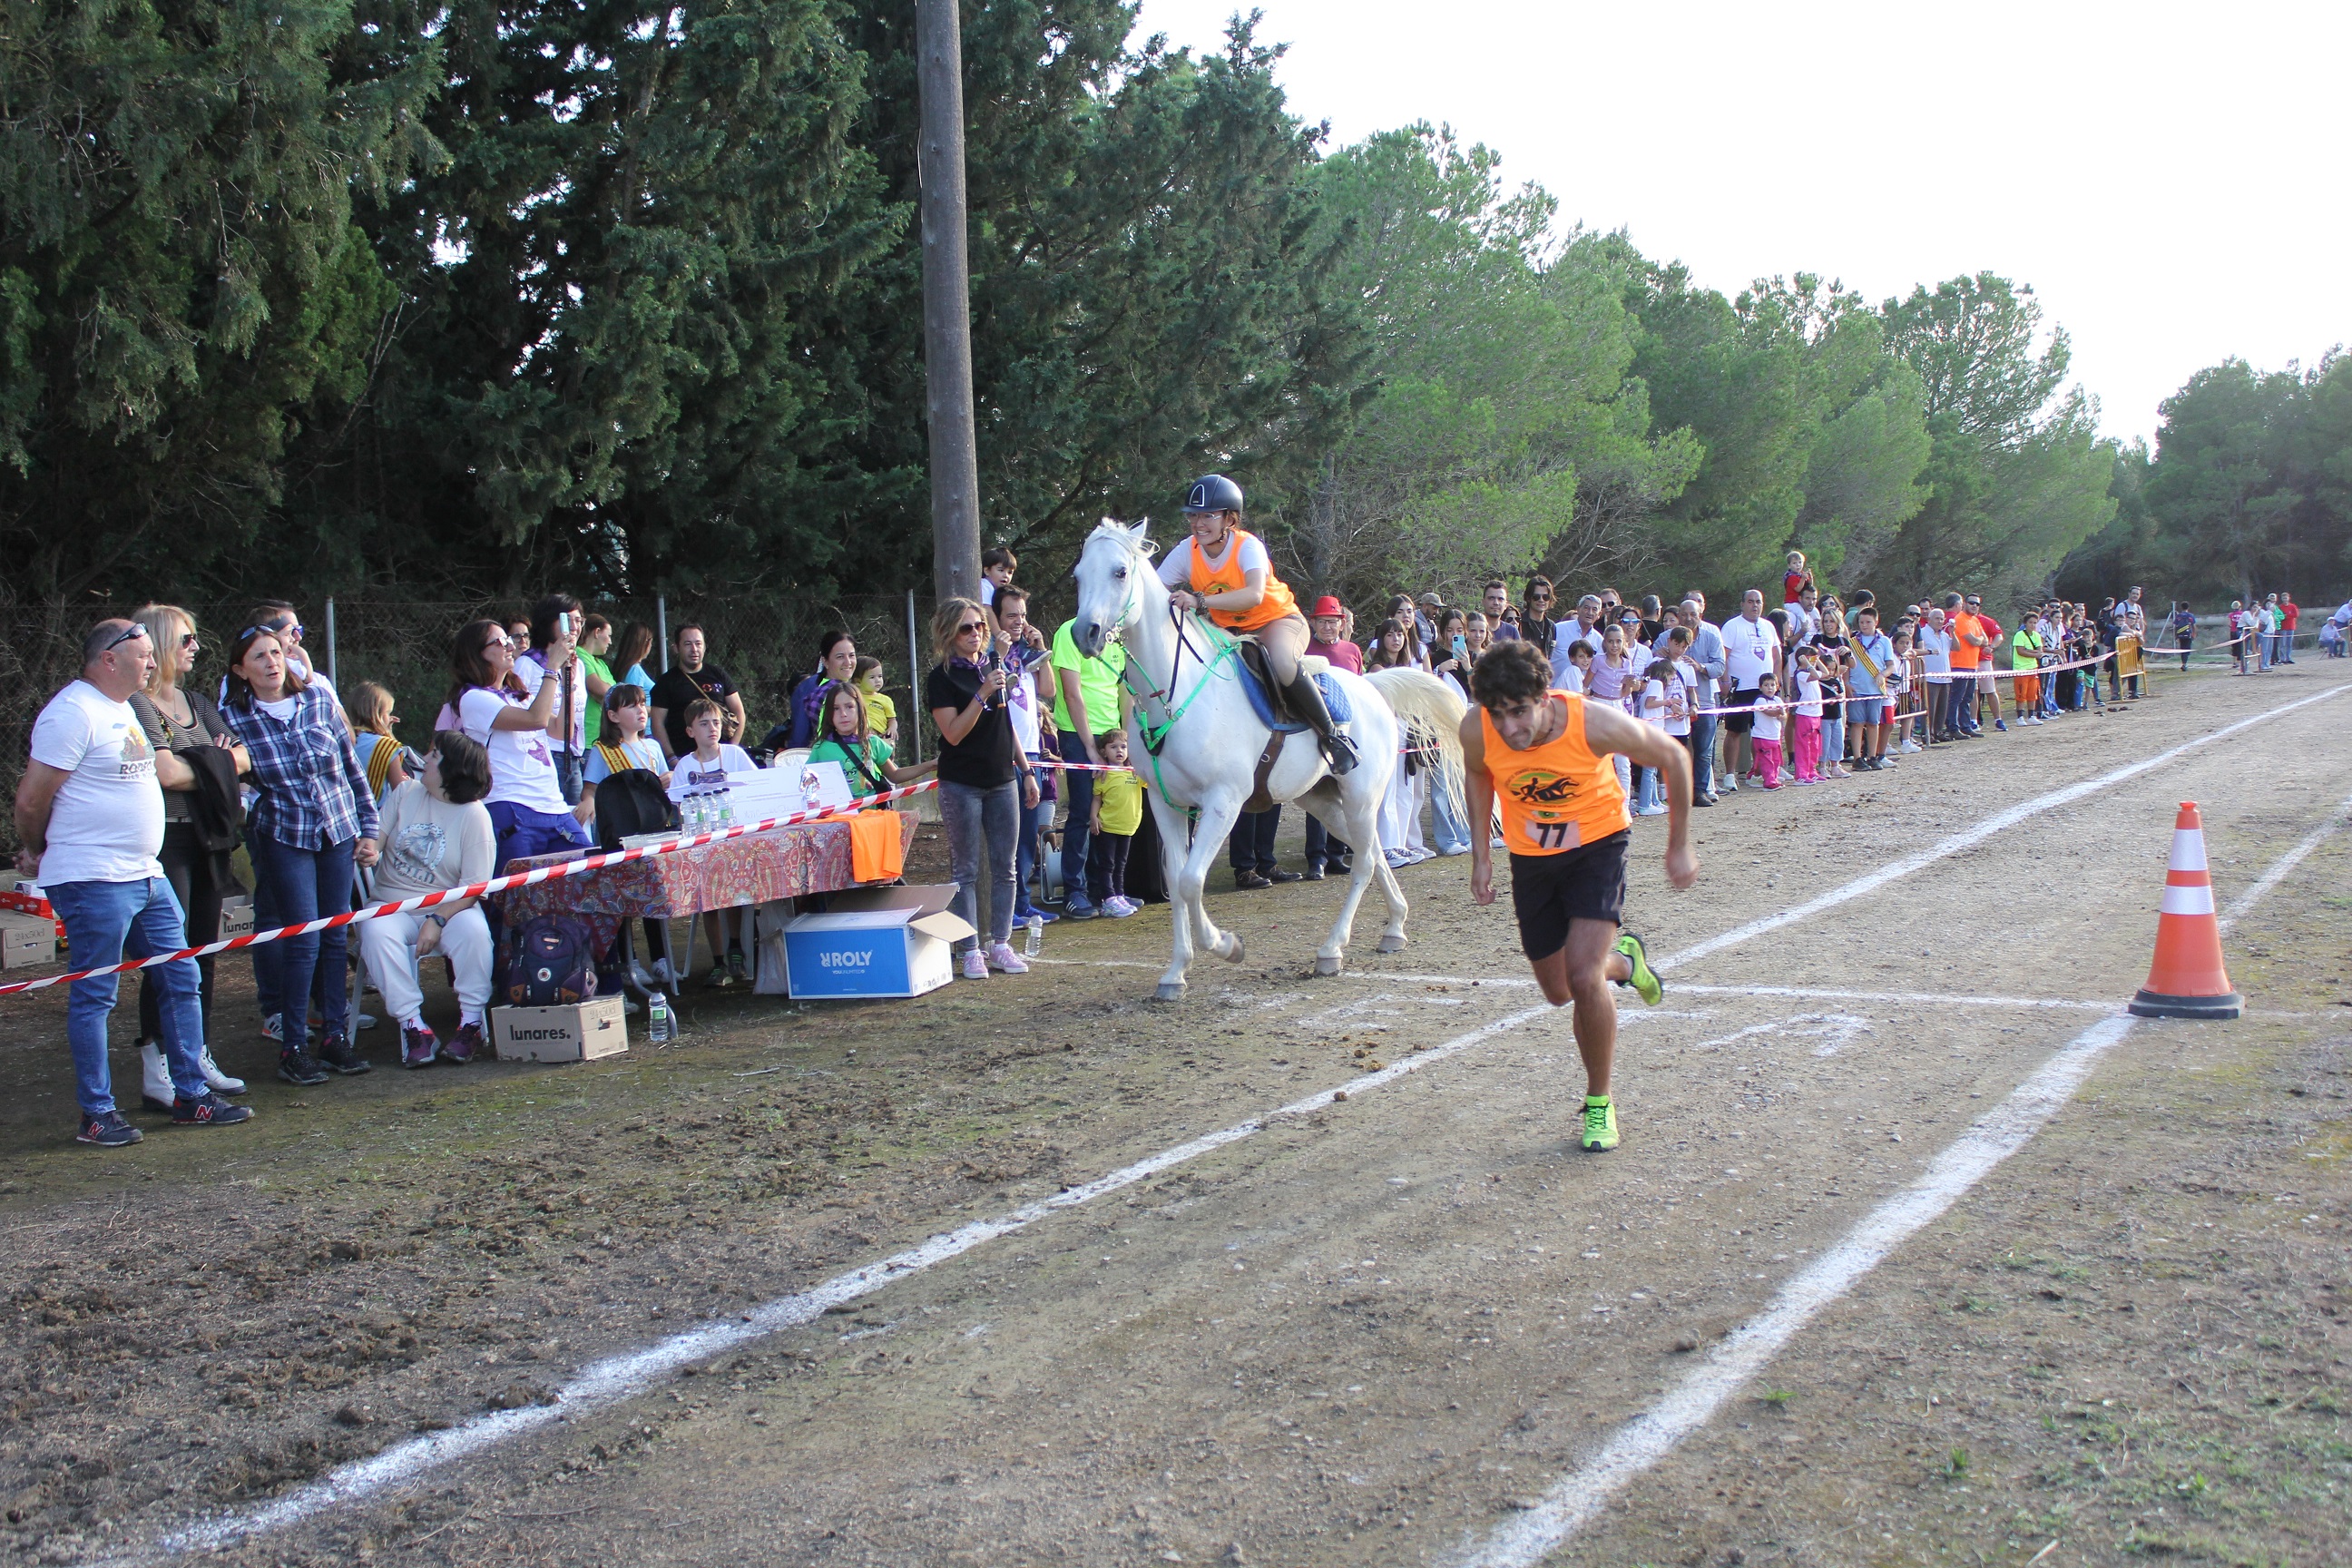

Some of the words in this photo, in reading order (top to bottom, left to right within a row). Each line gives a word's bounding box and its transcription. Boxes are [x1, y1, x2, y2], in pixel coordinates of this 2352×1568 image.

[1536, 822, 1568, 848] 77
[831, 951, 873, 968] ROLY
[509, 1024, 571, 1041] lunares.
